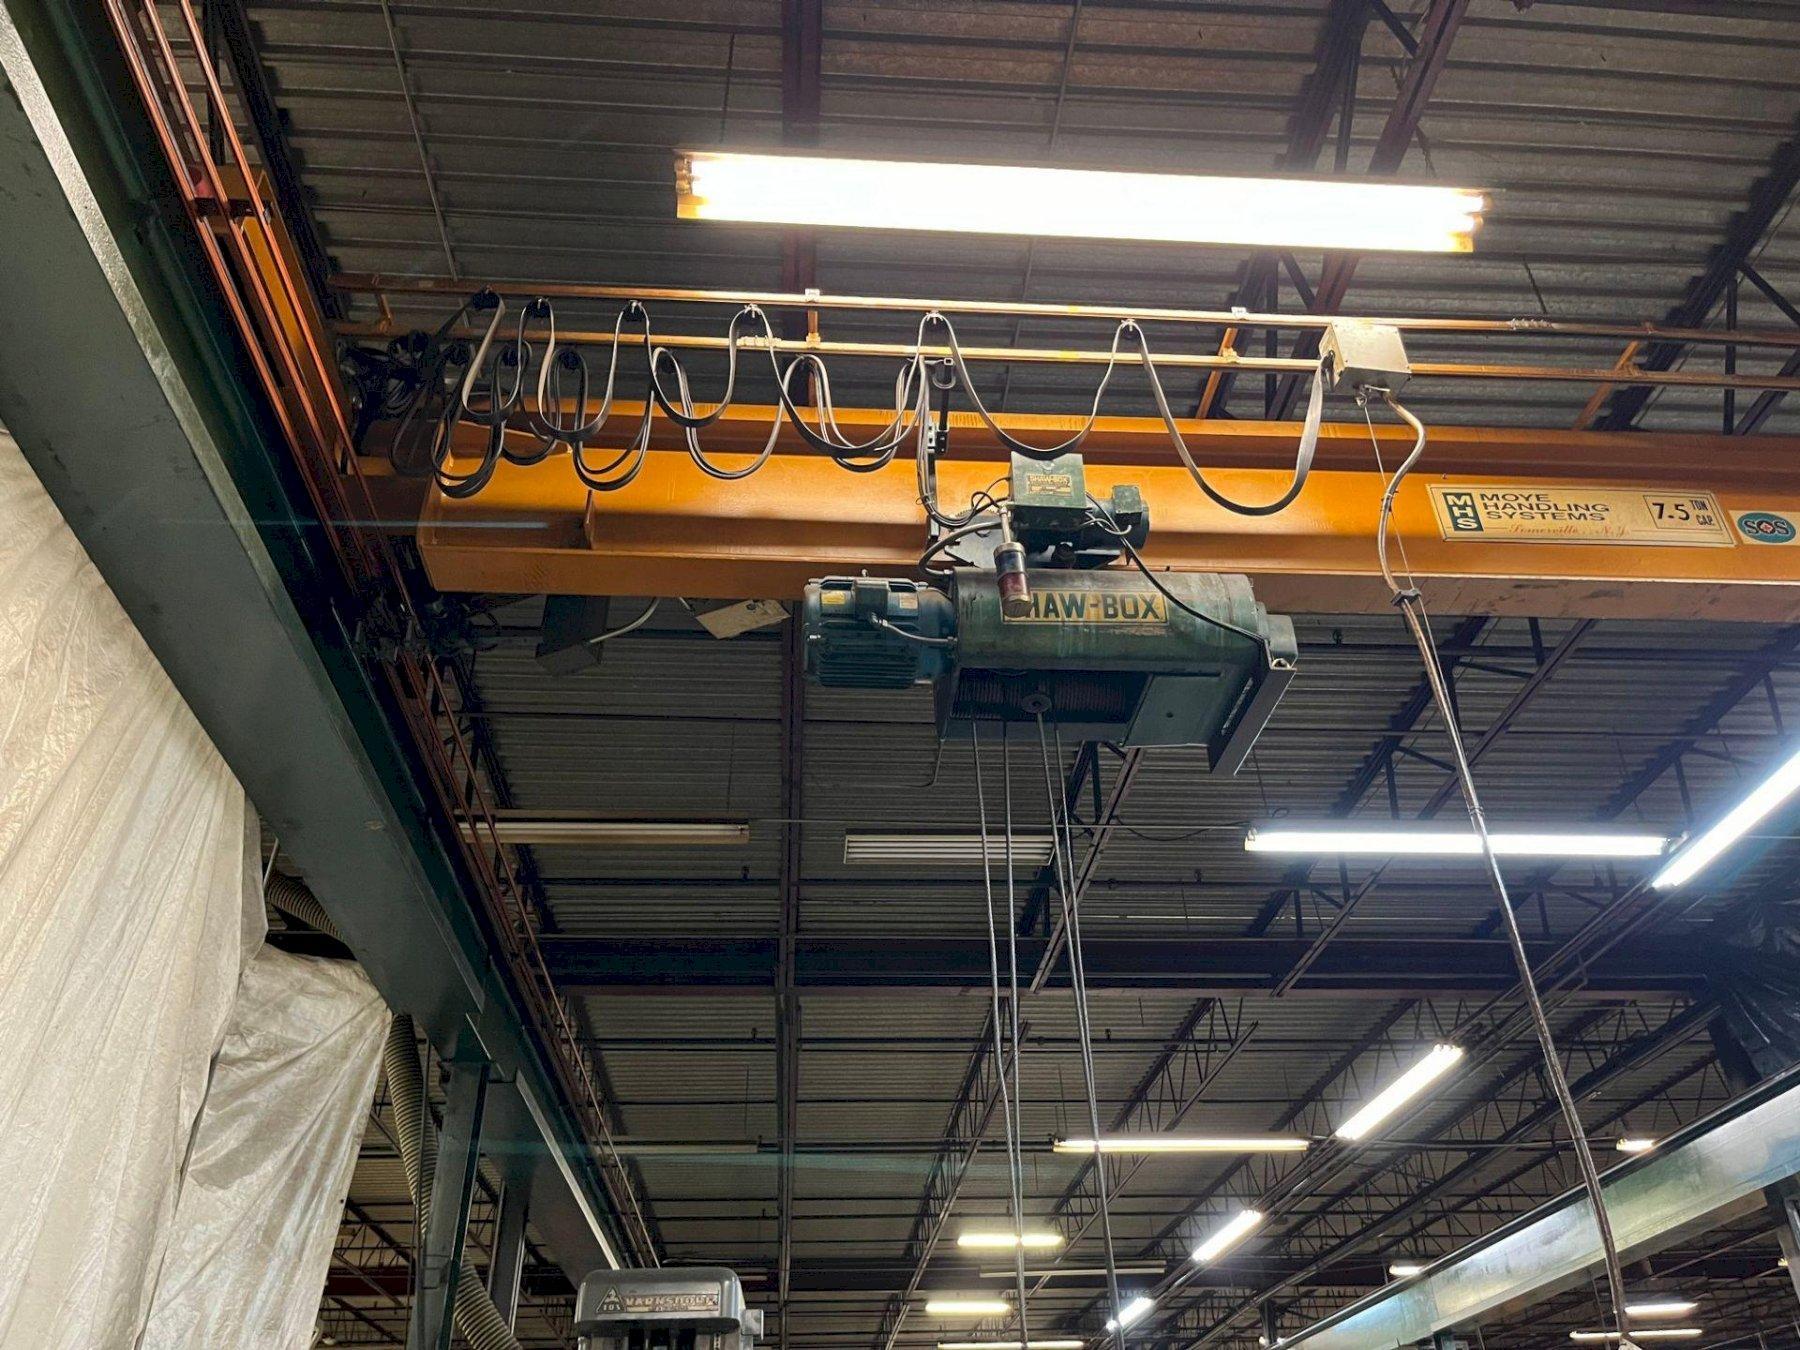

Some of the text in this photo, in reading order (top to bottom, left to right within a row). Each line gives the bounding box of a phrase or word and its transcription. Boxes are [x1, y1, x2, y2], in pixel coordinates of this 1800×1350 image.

[1480, 493, 1551, 502] MOYE
[1446, 494, 1478, 530] MHS
[1483, 502, 1610, 512] HANDLING
[1652, 502, 1690, 521] 7.5
[1690, 499, 1708, 511] TON
[1486, 511, 1605, 521] SYSTEMS
[1744, 518, 1789, 535] SOS
[1024, 592, 1160, 620] HAW-BOX
